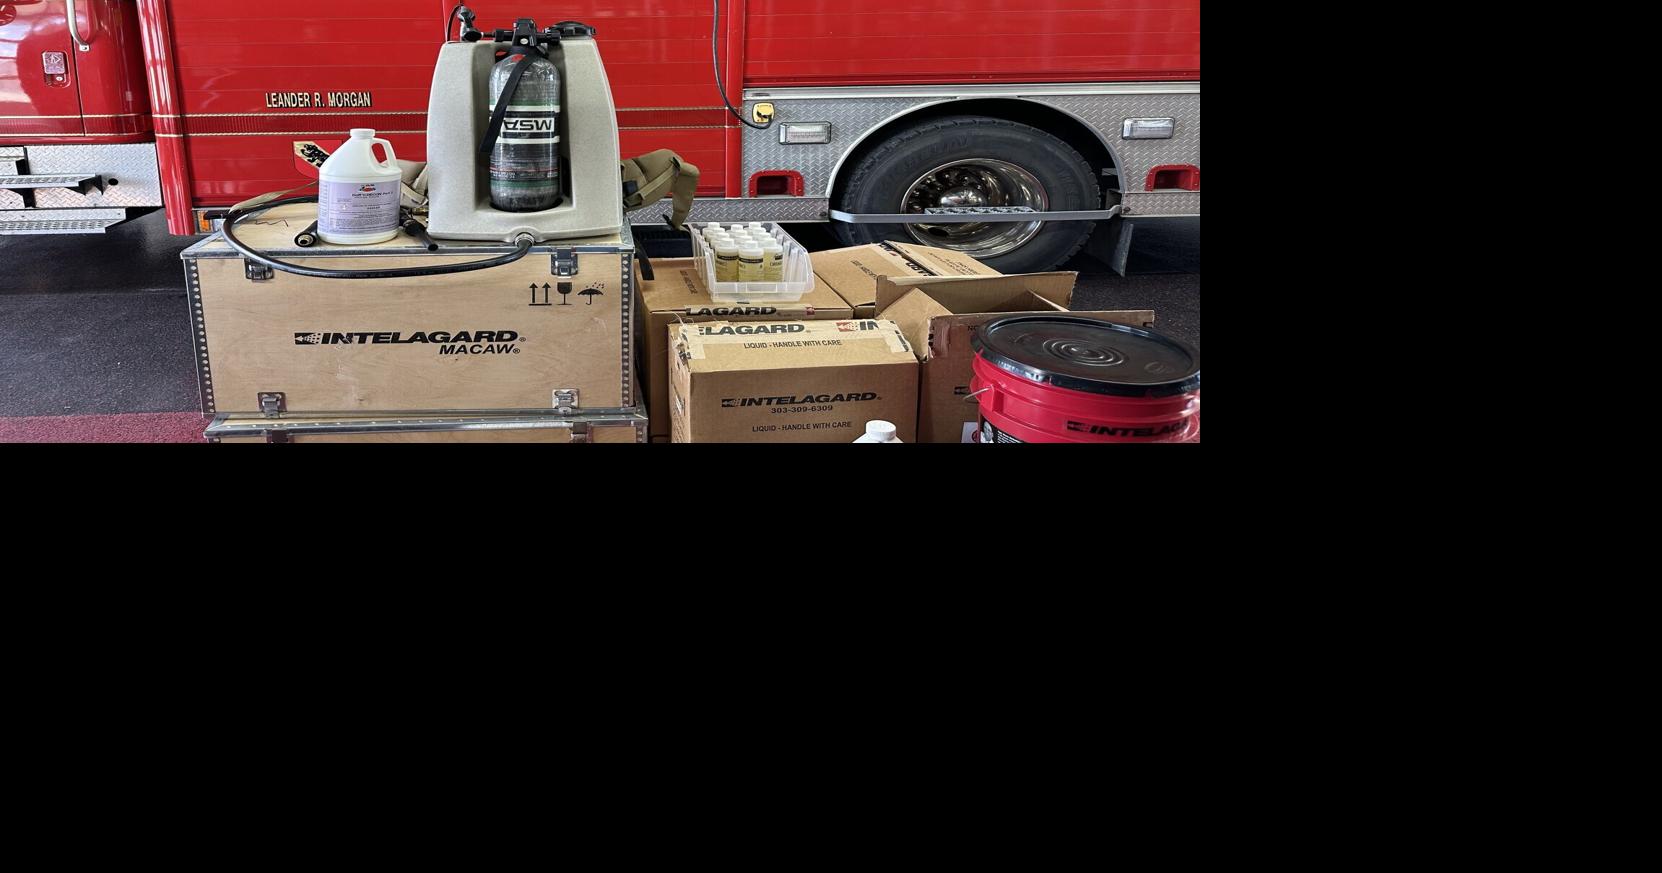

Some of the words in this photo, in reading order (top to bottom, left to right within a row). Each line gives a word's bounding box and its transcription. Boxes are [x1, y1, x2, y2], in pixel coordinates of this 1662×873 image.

[265, 92, 311, 108] LEANDER
[314, 92, 326, 108] R.
[328, 92, 372, 108] MORGAN
[503, 119, 552, 131] MSA
[321, 330, 518, 345] INTELAGARD
[802, 339, 821, 347] WITH
[822, 339, 843, 347] CARE
[740, 391, 877, 407] INTELAGARD
[771, 405, 833, 414] 303-309-6309
[752, 424, 777, 433] LIQUID
[782, 423, 812, 431] HANDLE
[813, 422, 832, 430] WITH
[832, 421, 852, 429] CARE
